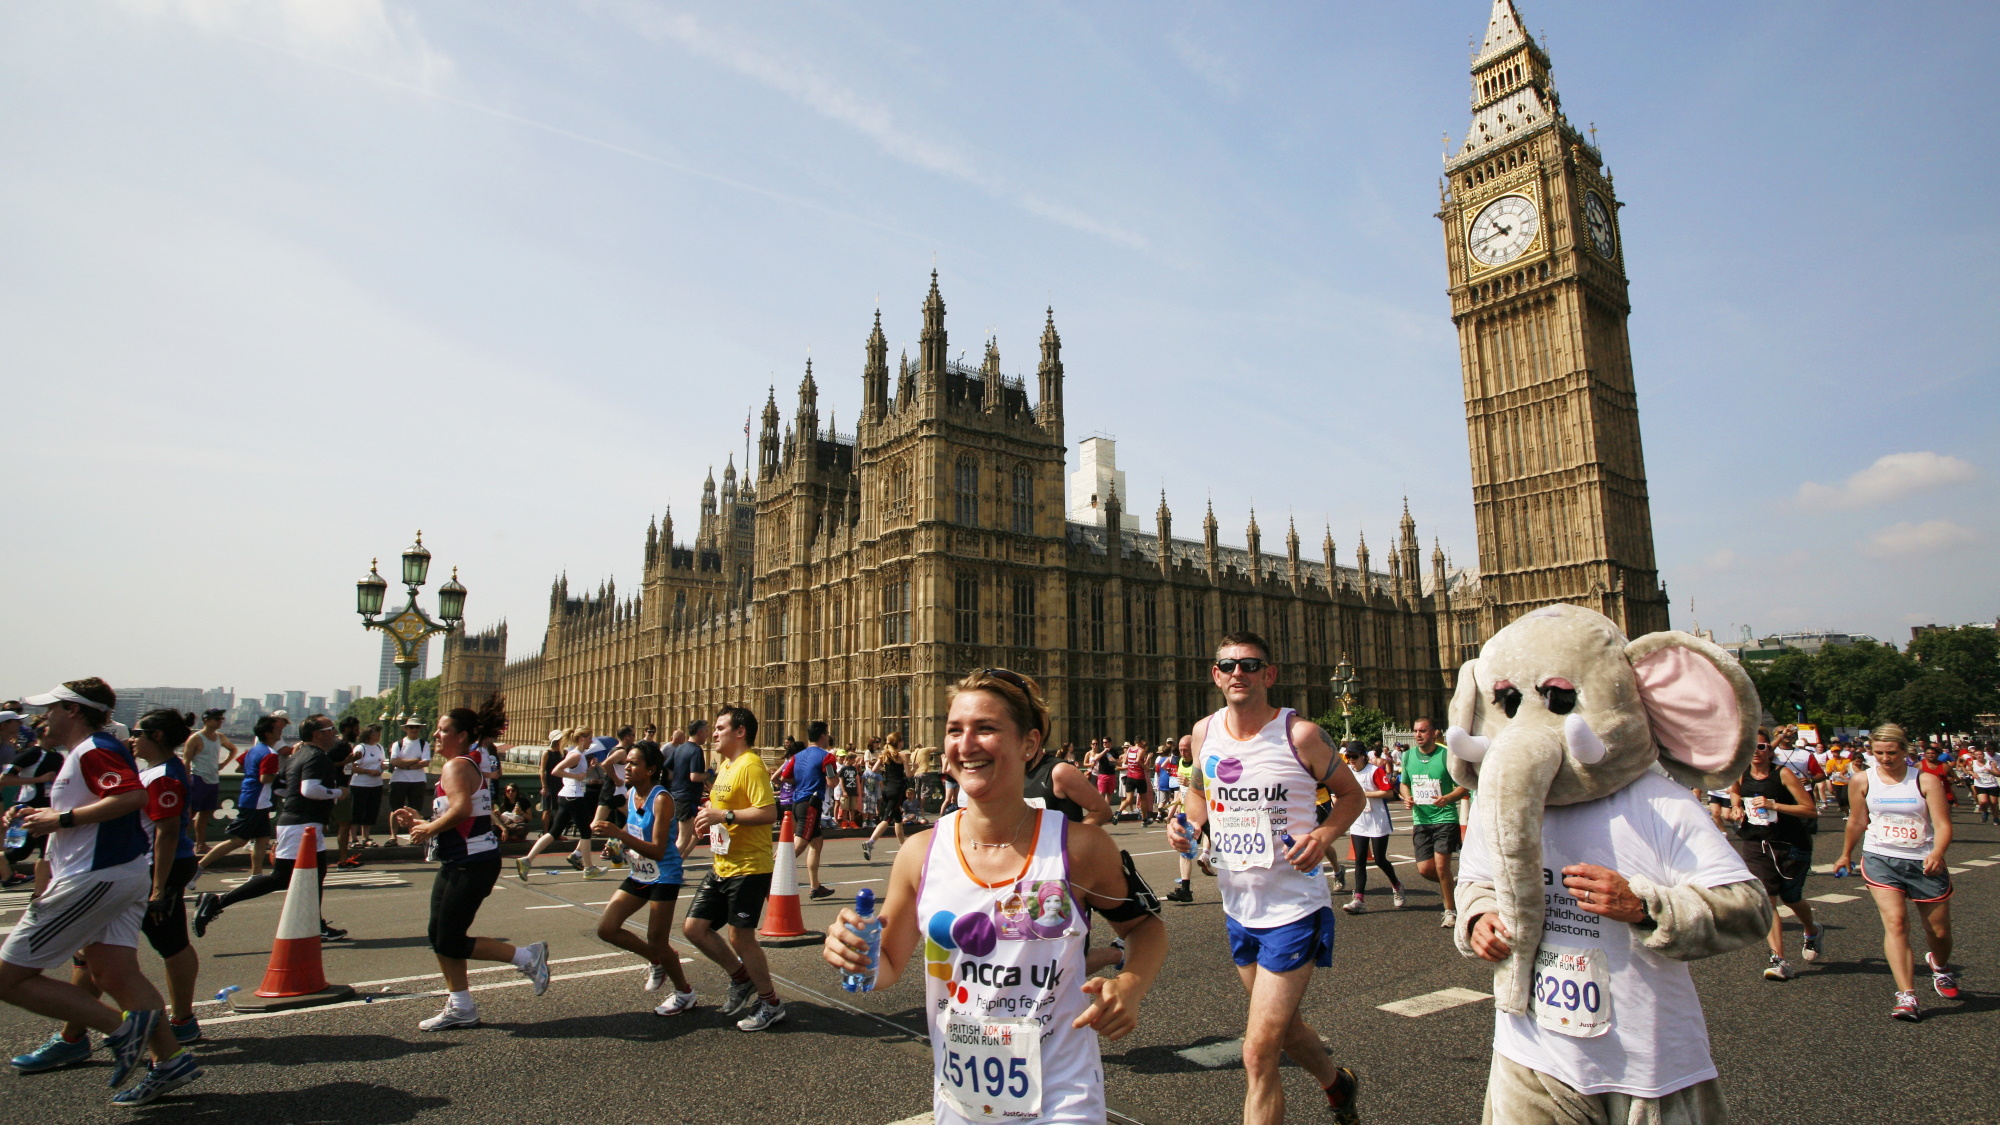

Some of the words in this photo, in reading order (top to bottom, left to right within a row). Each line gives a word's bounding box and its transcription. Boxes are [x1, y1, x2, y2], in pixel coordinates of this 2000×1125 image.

[1217, 786, 1259, 801] ncca
[1264, 783, 1289, 801] uk
[1883, 825, 1917, 839] 7598
[1214, 831, 1266, 854] 28289
[1559, 962, 1575, 971] RUN
[1561, 954, 1574, 963] 10K
[961, 961, 1021, 988] ncca
[1031, 959, 1064, 990] uk
[1535, 971, 1600, 1013] 8290
[976, 994, 1017, 1012] helping
[949, 1023, 980, 1035] BRITISH
[983, 1025, 999, 1036] 10K
[950, 1033, 979, 1045] LONDON
[982, 1035, 1000, 1046] RUN
[942, 1041, 1029, 1098] 25195
